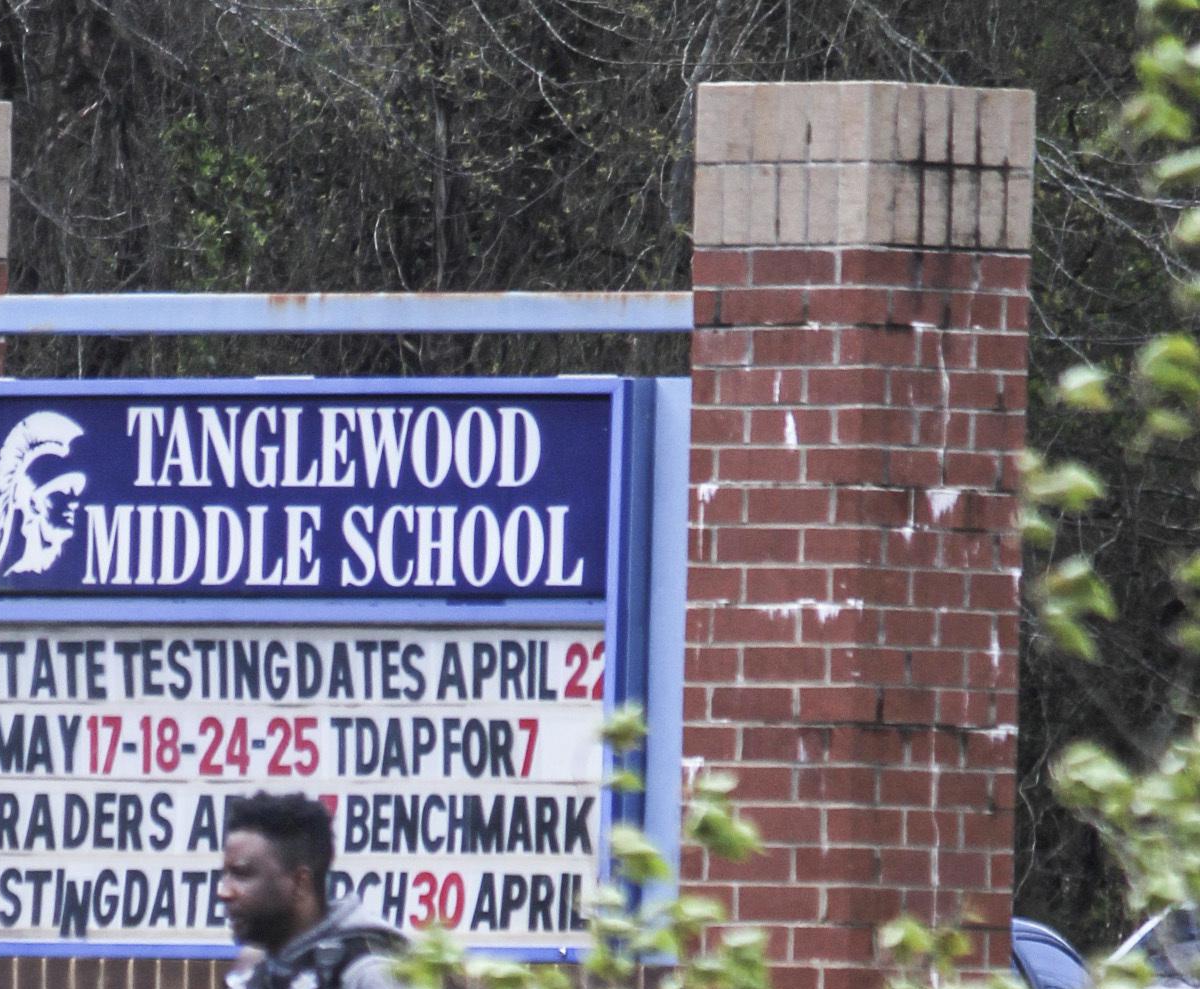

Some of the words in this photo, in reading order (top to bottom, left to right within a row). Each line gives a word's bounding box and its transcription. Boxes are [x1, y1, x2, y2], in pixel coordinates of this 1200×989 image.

[127, 405, 541, 488] TANGLEWOOD
[81, 504, 321, 586] MIDDLE
[341, 504, 584, 588] SCHOOL
[114, 639, 290, 700] TESTING
[296, 640, 427, 701] DATES
[436, 640, 558, 701] APRIL
[86, 715, 320, 776] 17-18-24-25
[330, 716, 437, 777] TDAP
[442, 717, 516, 778] FOR
[518, 718, 539, 778] 7
[344, 794, 596, 855] BENCHMARK
[121, 869, 225, 928] DATE
[409, 870, 466, 931] 30
[469, 872, 592, 932] APRIL
